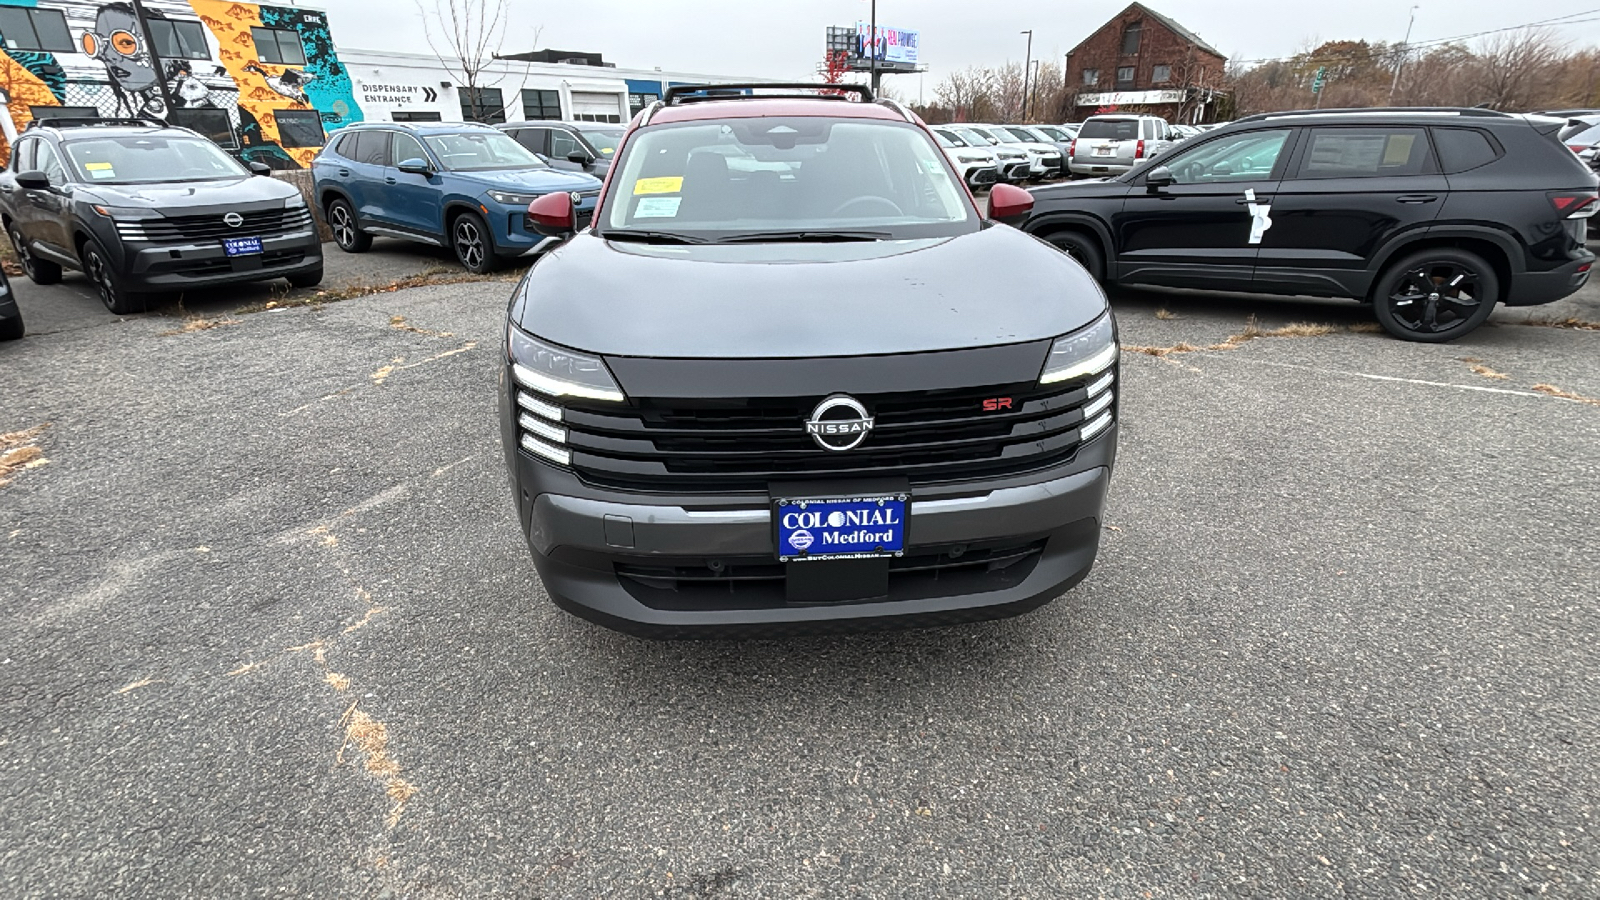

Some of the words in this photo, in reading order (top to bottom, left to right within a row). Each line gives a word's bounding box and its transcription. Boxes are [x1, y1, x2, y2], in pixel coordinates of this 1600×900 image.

[898, 31, 917, 48] PROMISE
[362, 84, 418, 94] DISPENSARY
[364, 94, 413, 104] ENTRANCE
[225, 239, 260, 249] COLONIAL
[982, 397, 1012, 411] SR
[807, 420, 873, 434] NISSAN
[783, 508, 899, 529] COLONIAL
[822, 529, 893, 545] Medford
